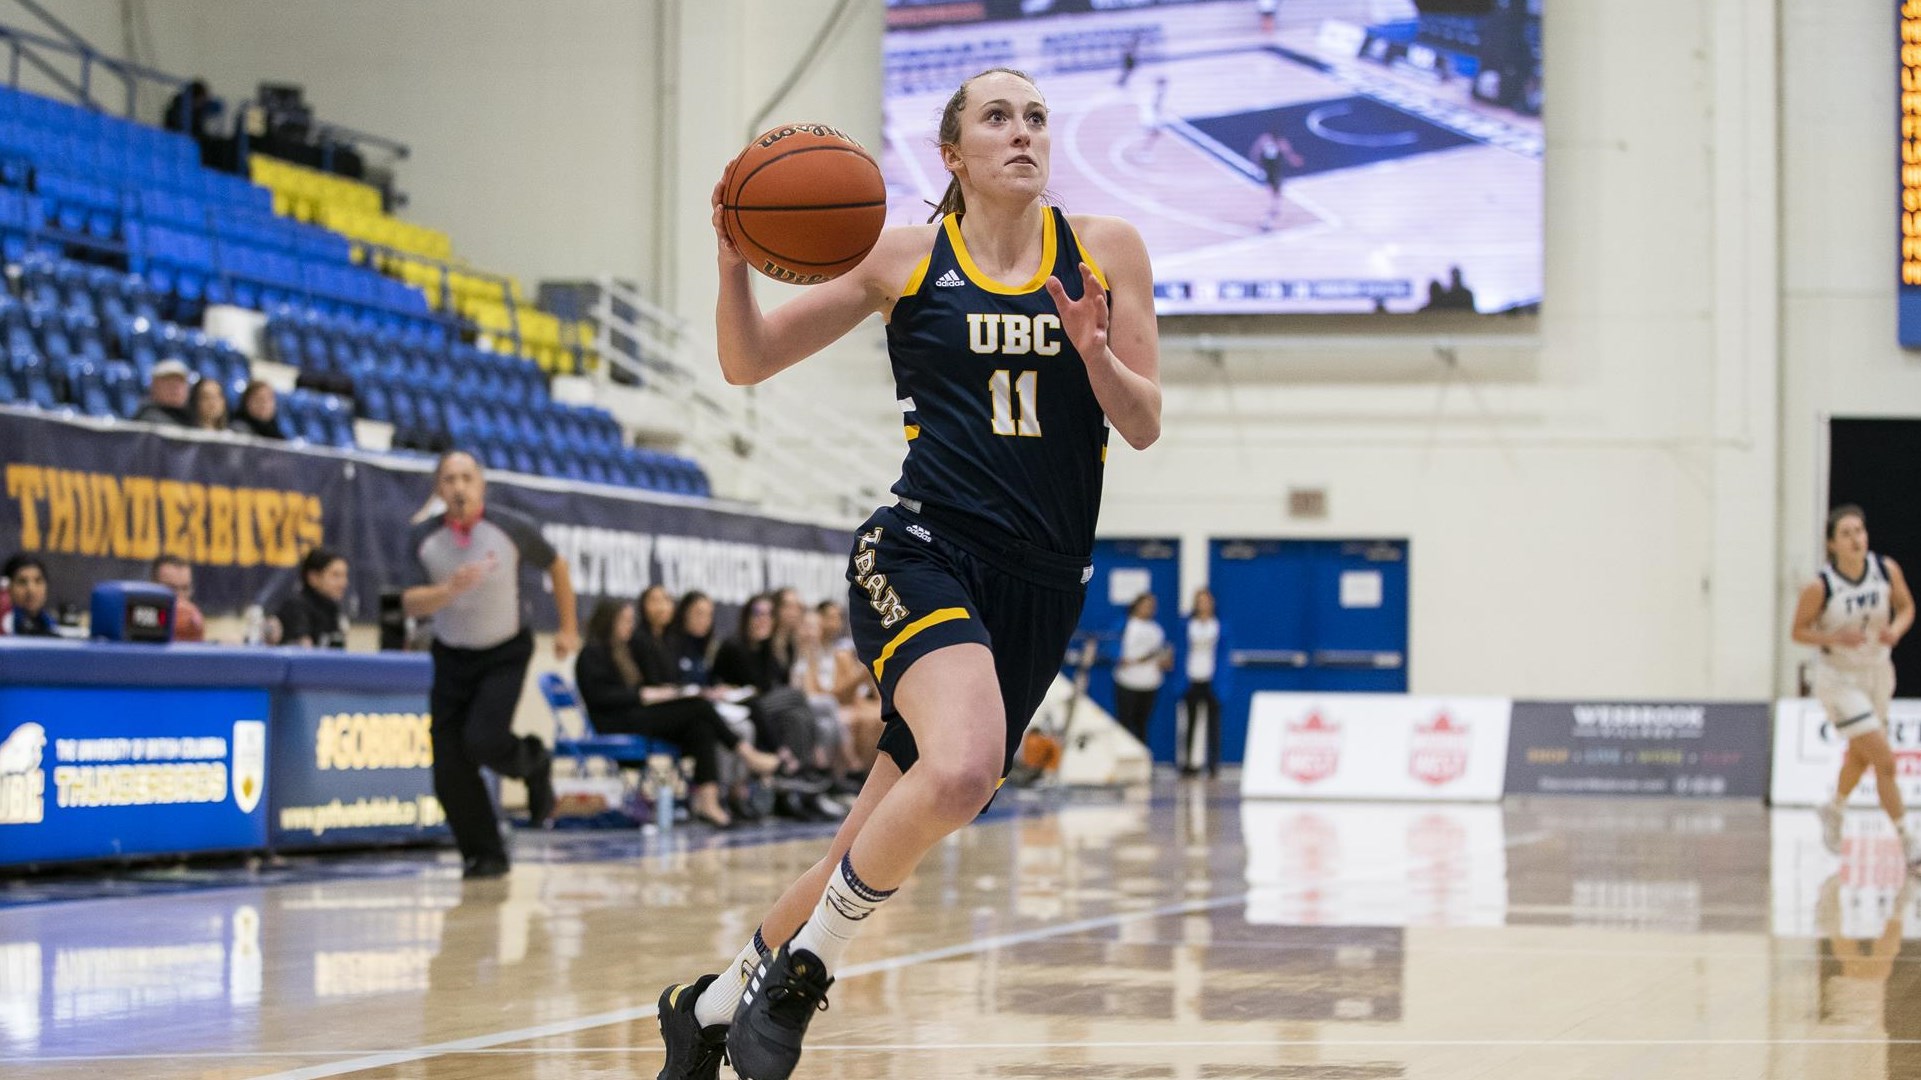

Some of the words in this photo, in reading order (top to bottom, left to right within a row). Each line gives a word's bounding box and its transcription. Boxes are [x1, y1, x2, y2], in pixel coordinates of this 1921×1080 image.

[935, 279, 965, 288] adidas
[966, 313, 1062, 357] UBC
[988, 369, 1043, 438] 11
[5, 463, 324, 568] THUNDERBIRDS
[906, 525, 932, 543] adidas
[1573, 705, 1706, 727] WESBROOK
